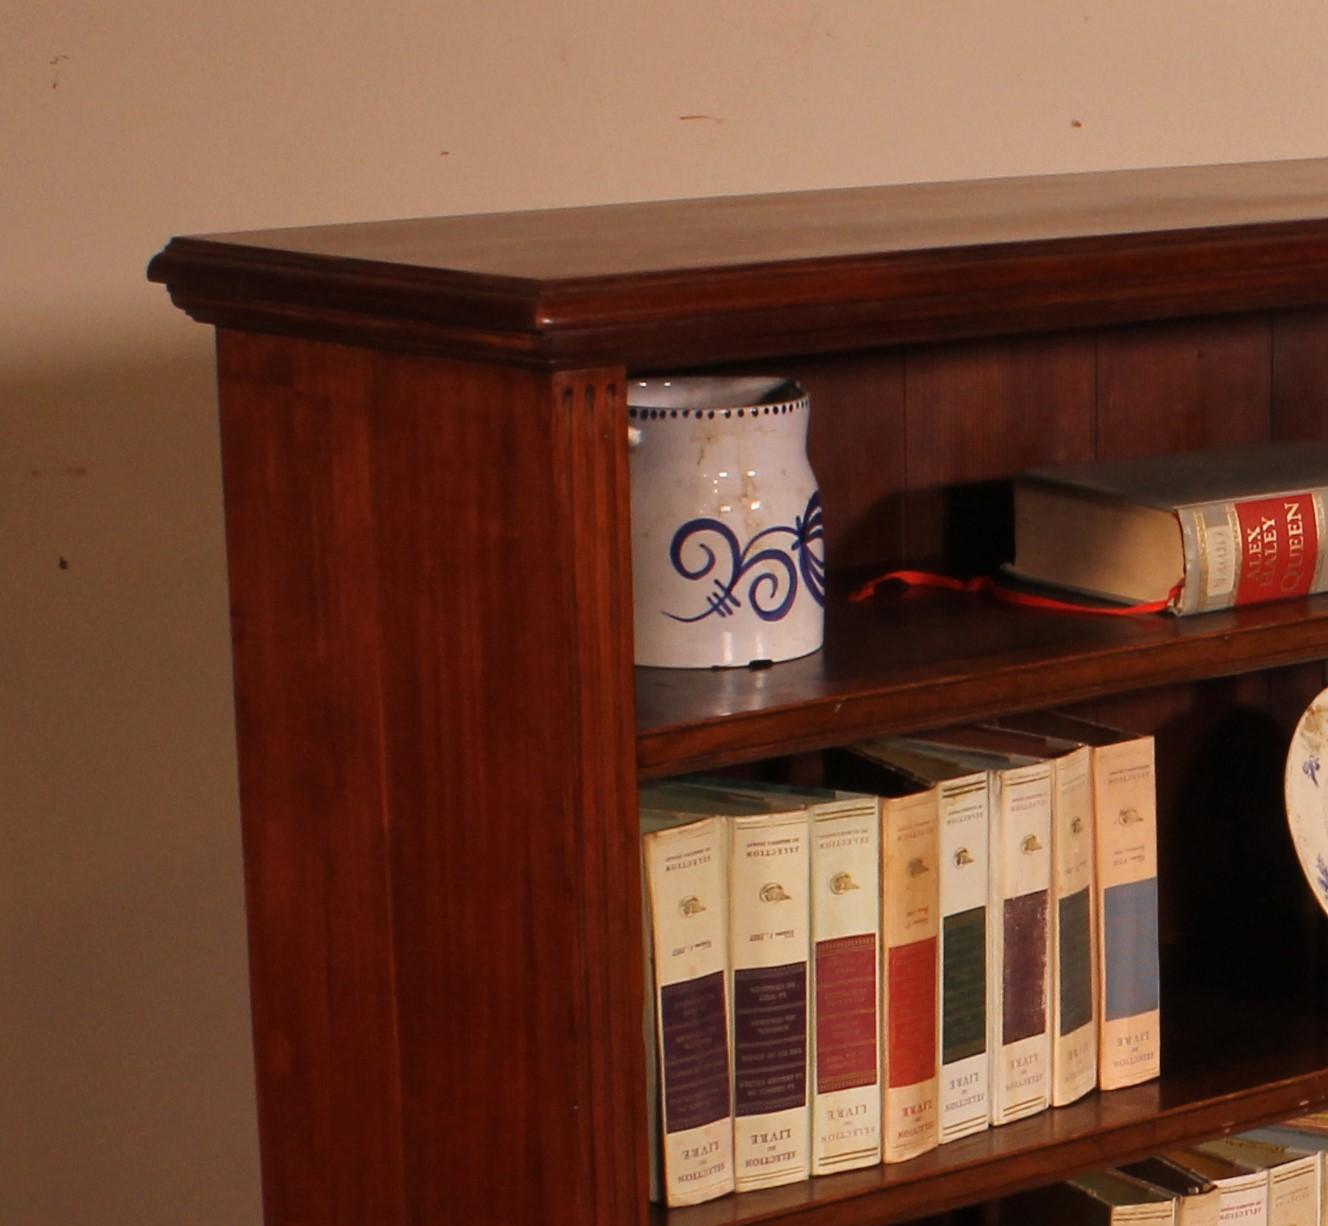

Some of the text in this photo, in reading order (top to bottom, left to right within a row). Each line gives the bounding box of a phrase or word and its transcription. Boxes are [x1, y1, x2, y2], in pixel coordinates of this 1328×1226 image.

[1246, 525, 1263, 580] ALEX
[1261, 516, 1278, 589] HALEY
[1280, 502, 1304, 593] QUEEN
[750, 1128, 791, 1145] LIVRE
[825, 1104, 867, 1120] LIVRE
